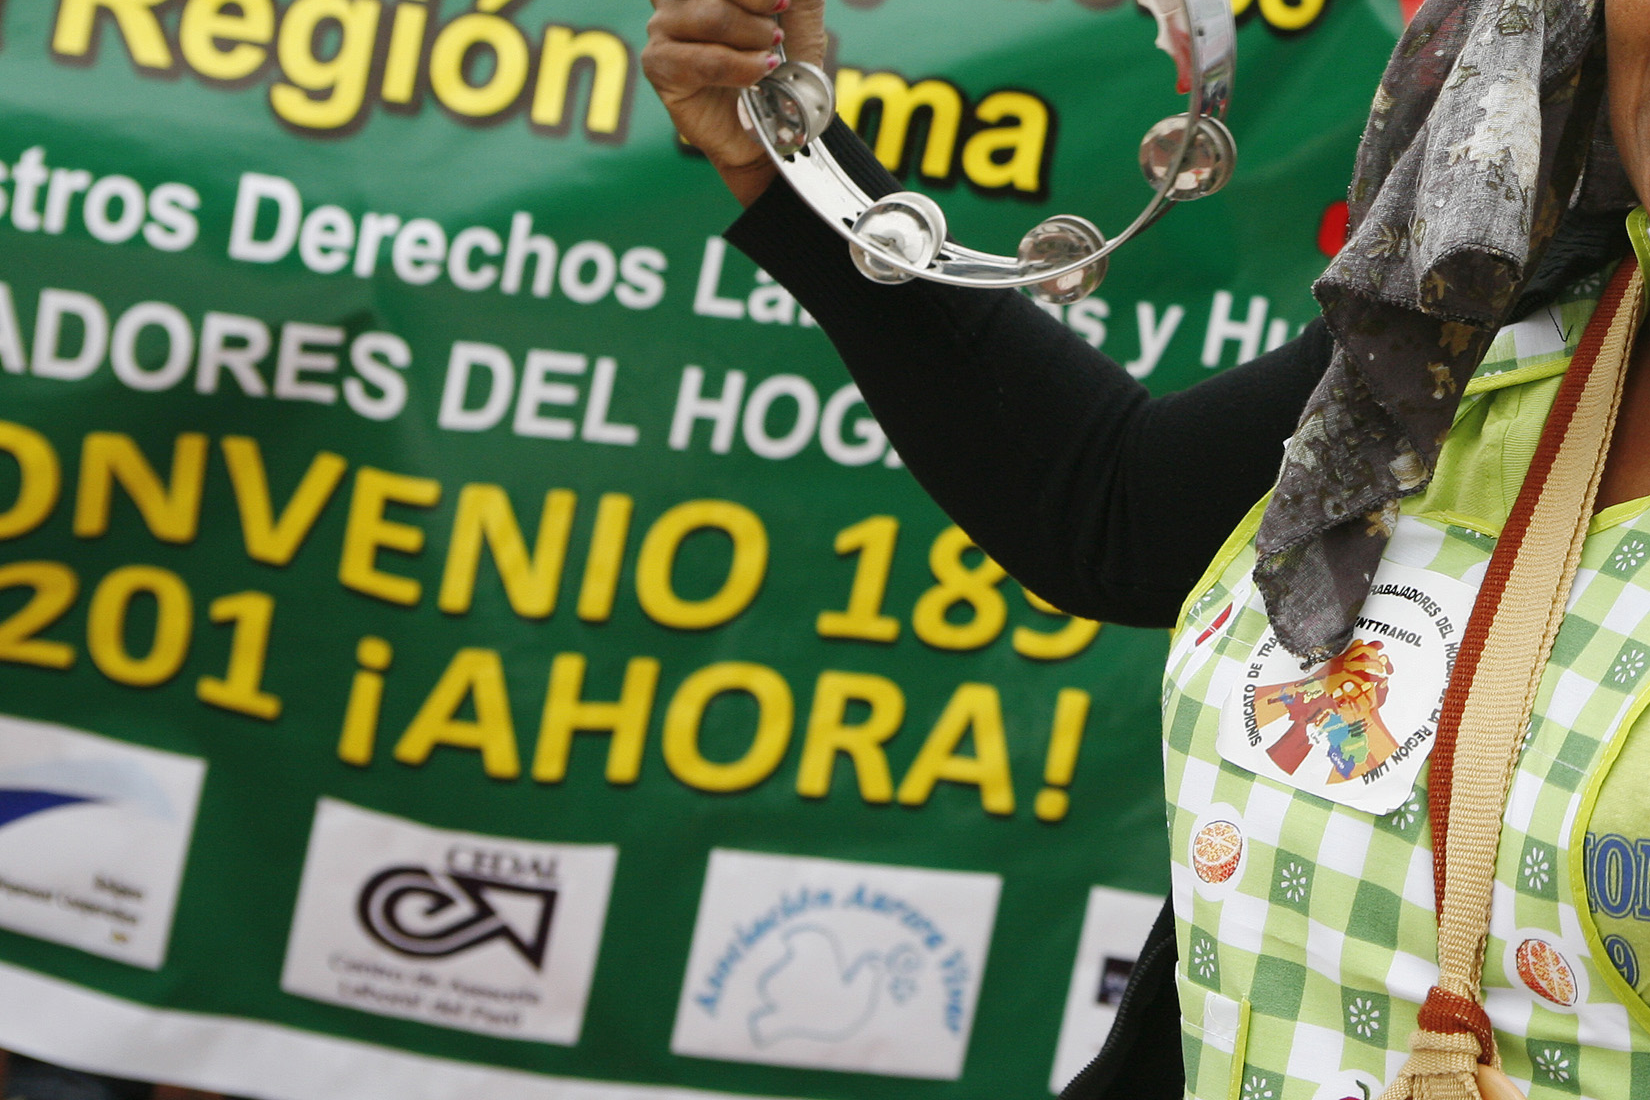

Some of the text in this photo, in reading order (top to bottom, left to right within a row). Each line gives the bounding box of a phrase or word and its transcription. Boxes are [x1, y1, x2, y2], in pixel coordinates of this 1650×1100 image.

[0, 145, 201, 252] tros
[228, 171, 670, 310] Derechos
[437, 339, 640, 448] DEL
[667, 363, 901, 468] HOG
[1369, 584, 1442, 618] RABAJADORES
[1356, 616, 1423, 647] NTTRAHOL
[1435, 615, 1455, 640] DEL
[1247, 662, 1263, 679] DE
[336, 634, 1092, 822] ¡AHORA!
[1243, 683, 1262, 747] SINDICATO
[1361, 760, 1391, 786] LIMA
